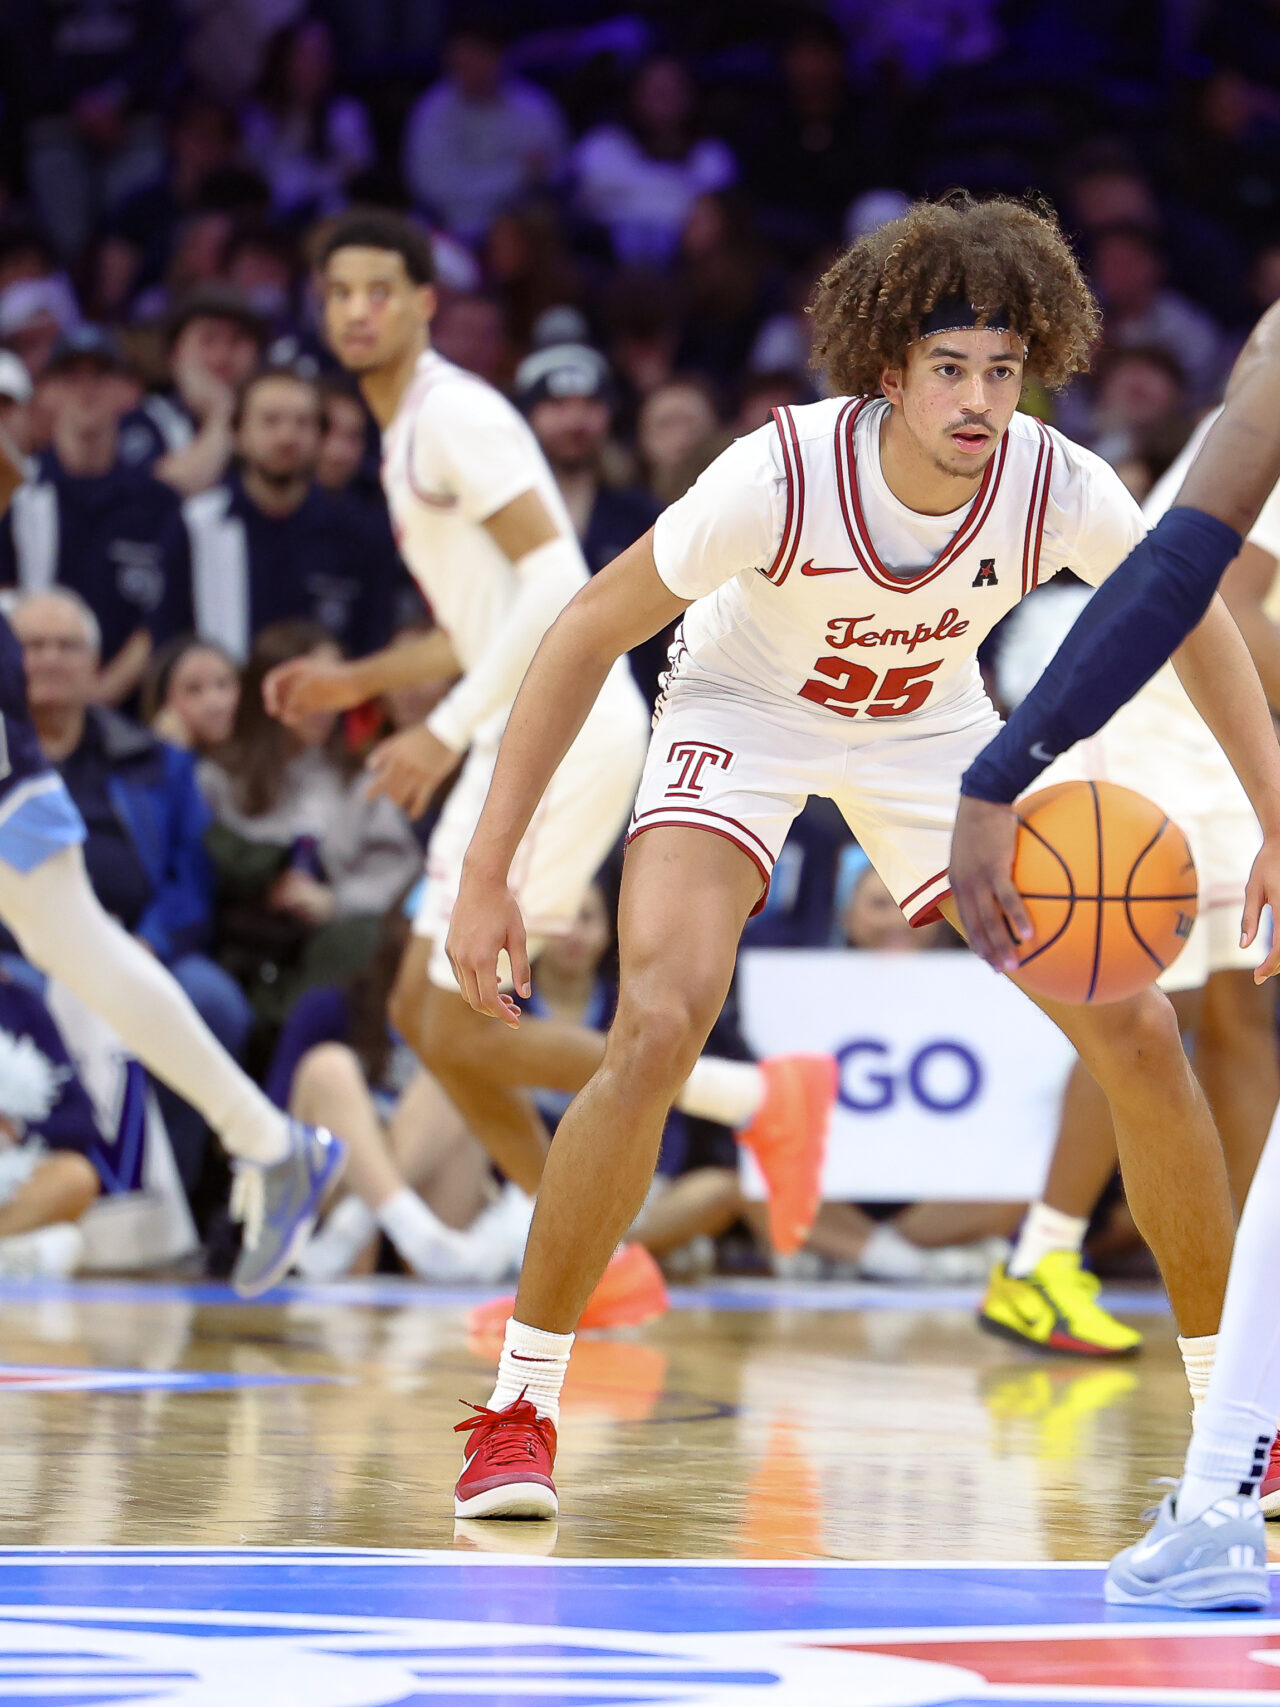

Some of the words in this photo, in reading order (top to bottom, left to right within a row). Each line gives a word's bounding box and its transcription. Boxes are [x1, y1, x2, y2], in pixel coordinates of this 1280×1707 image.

[971, 558, 999, 588] A
[825, 607, 970, 654] Temple
[797, 655, 945, 718] 25
[664, 740, 735, 800] T
[835, 1039, 984, 1114] GO
